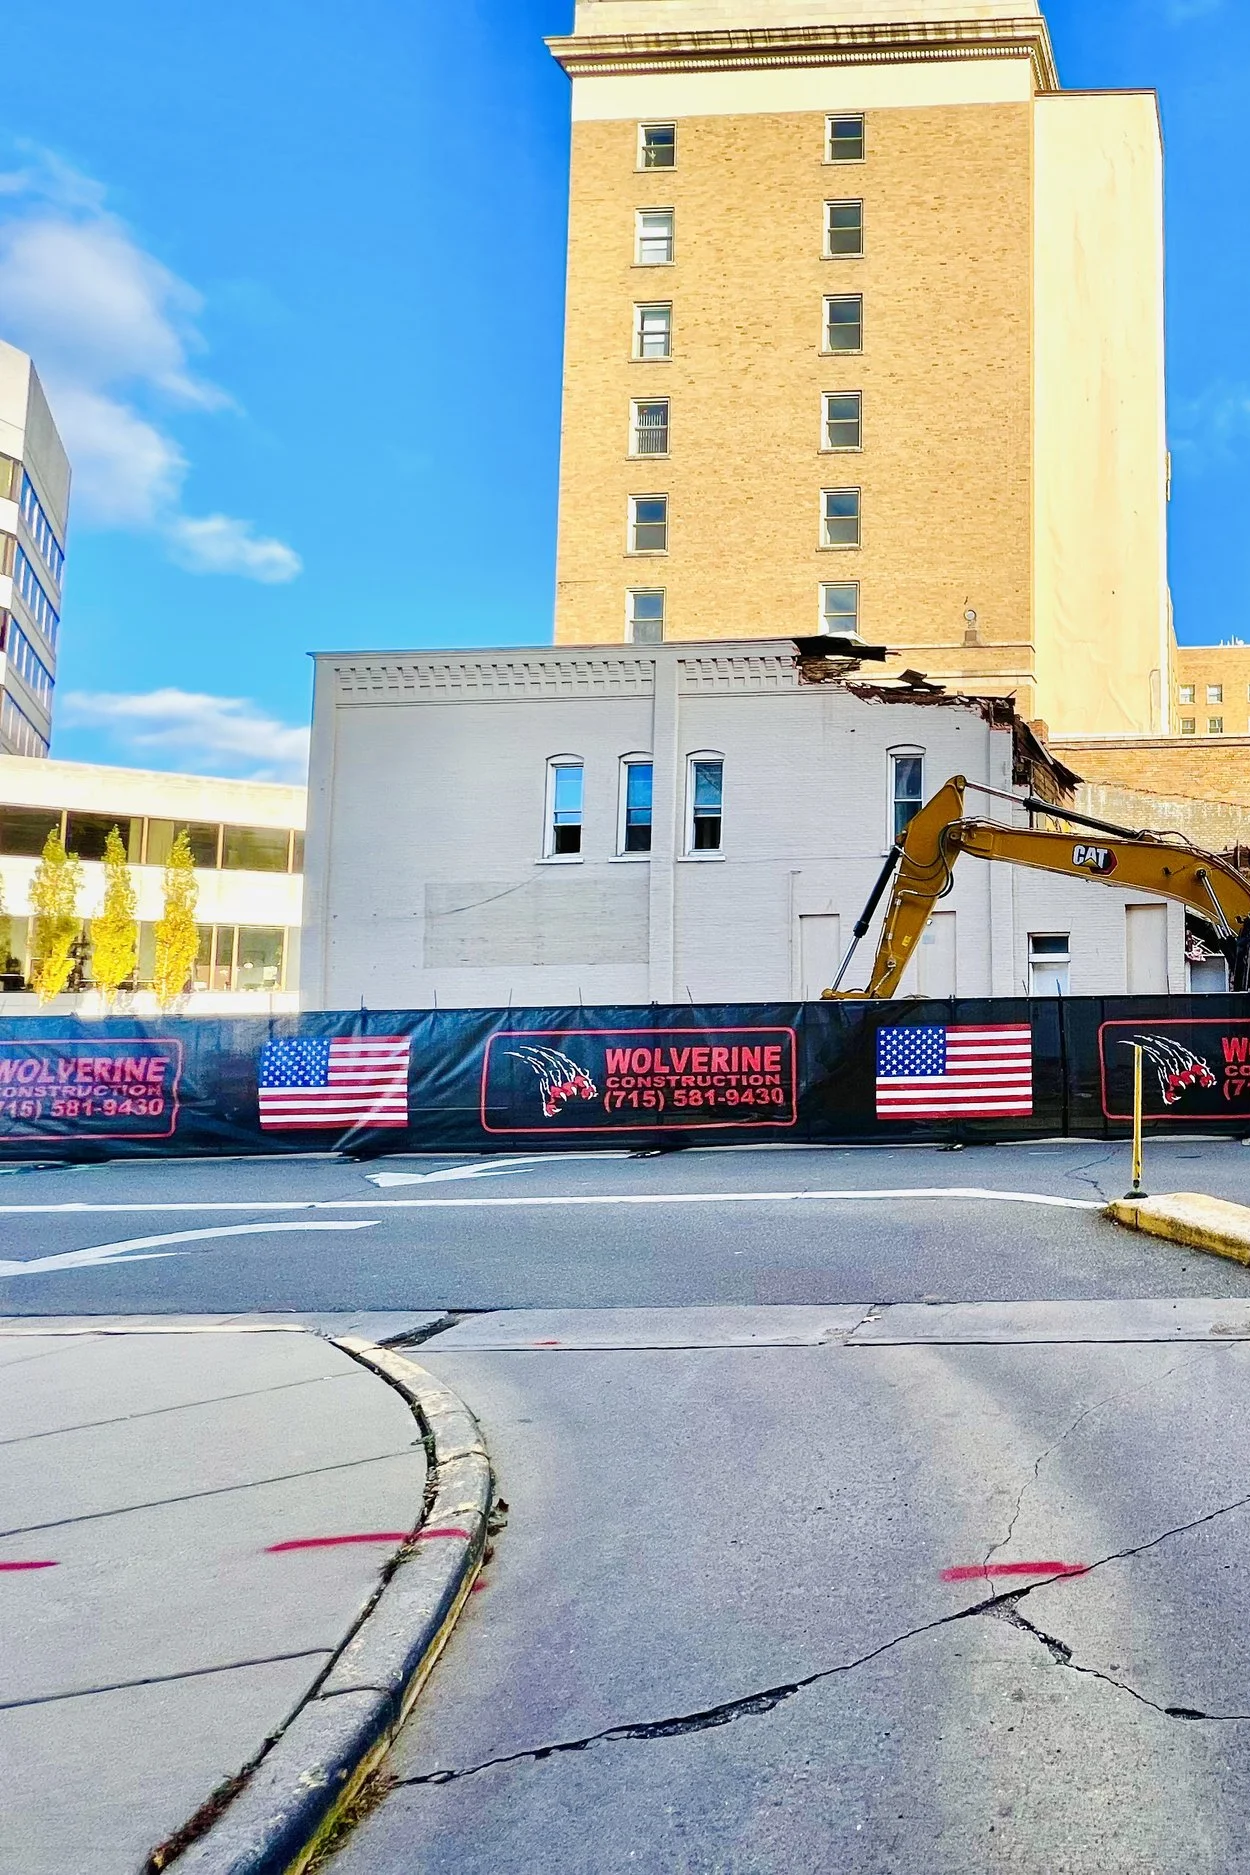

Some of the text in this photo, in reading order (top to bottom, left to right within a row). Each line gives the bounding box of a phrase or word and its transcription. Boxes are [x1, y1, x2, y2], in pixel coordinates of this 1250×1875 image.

[1073, 844, 1108, 869] CAT
[605, 1045, 783, 1075] WOLVERINE
[0, 1085, 163, 1098] ONSTRUCTION
[605, 1074, 781, 1089] CONSTRUCTION
[51, 1098, 164, 1118] 581-9430
[604, 1087, 784, 1113] (715) 581-9430
